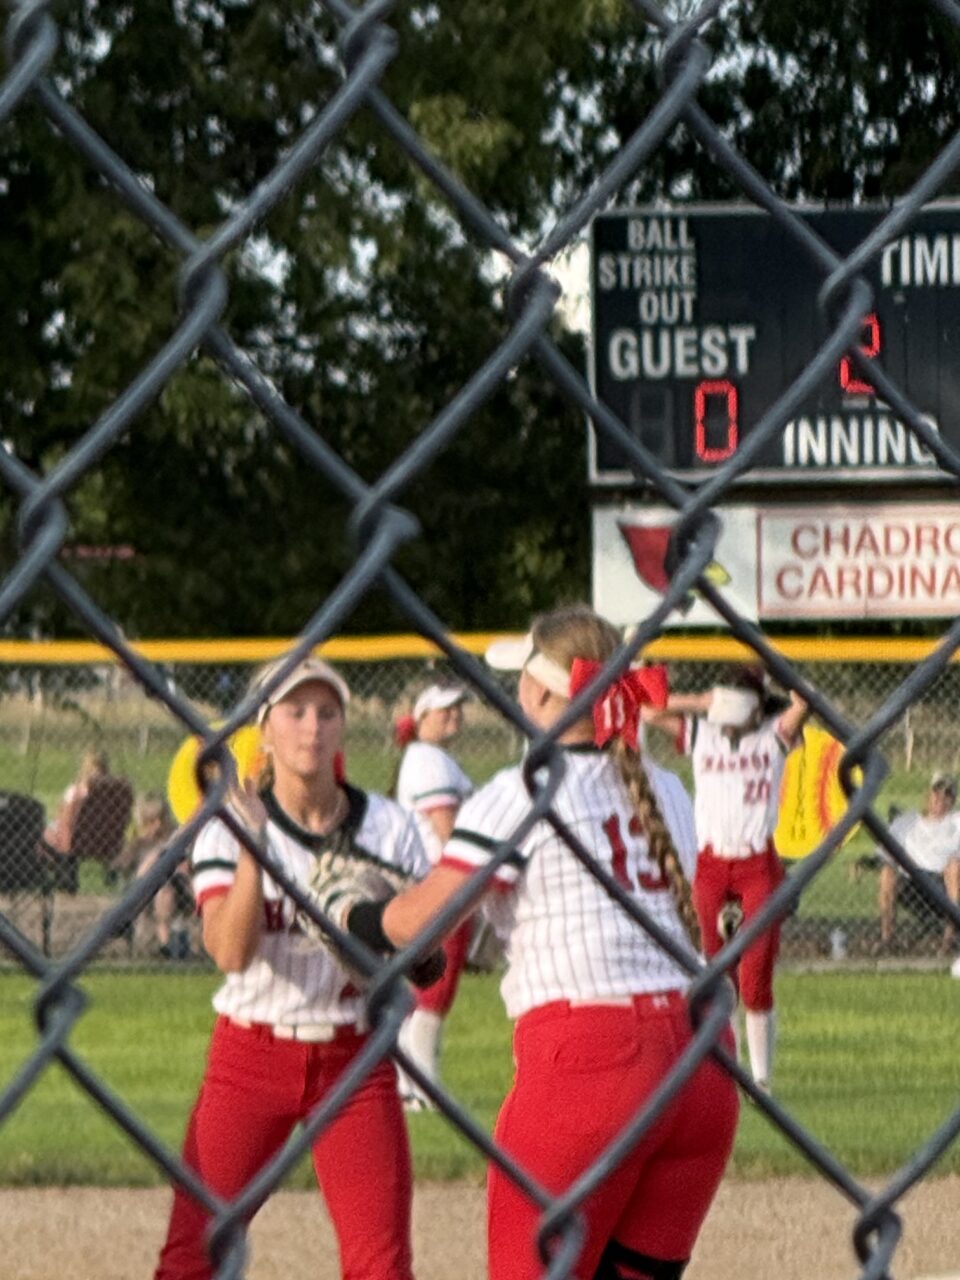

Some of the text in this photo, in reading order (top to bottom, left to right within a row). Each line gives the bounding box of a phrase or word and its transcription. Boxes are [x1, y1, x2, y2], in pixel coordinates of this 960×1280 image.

[628, 220, 693, 249] BALL
[598, 256, 695, 289] STRIKE
[640, 292, 695, 322] OUT
[608, 328, 754, 377] GUEST
